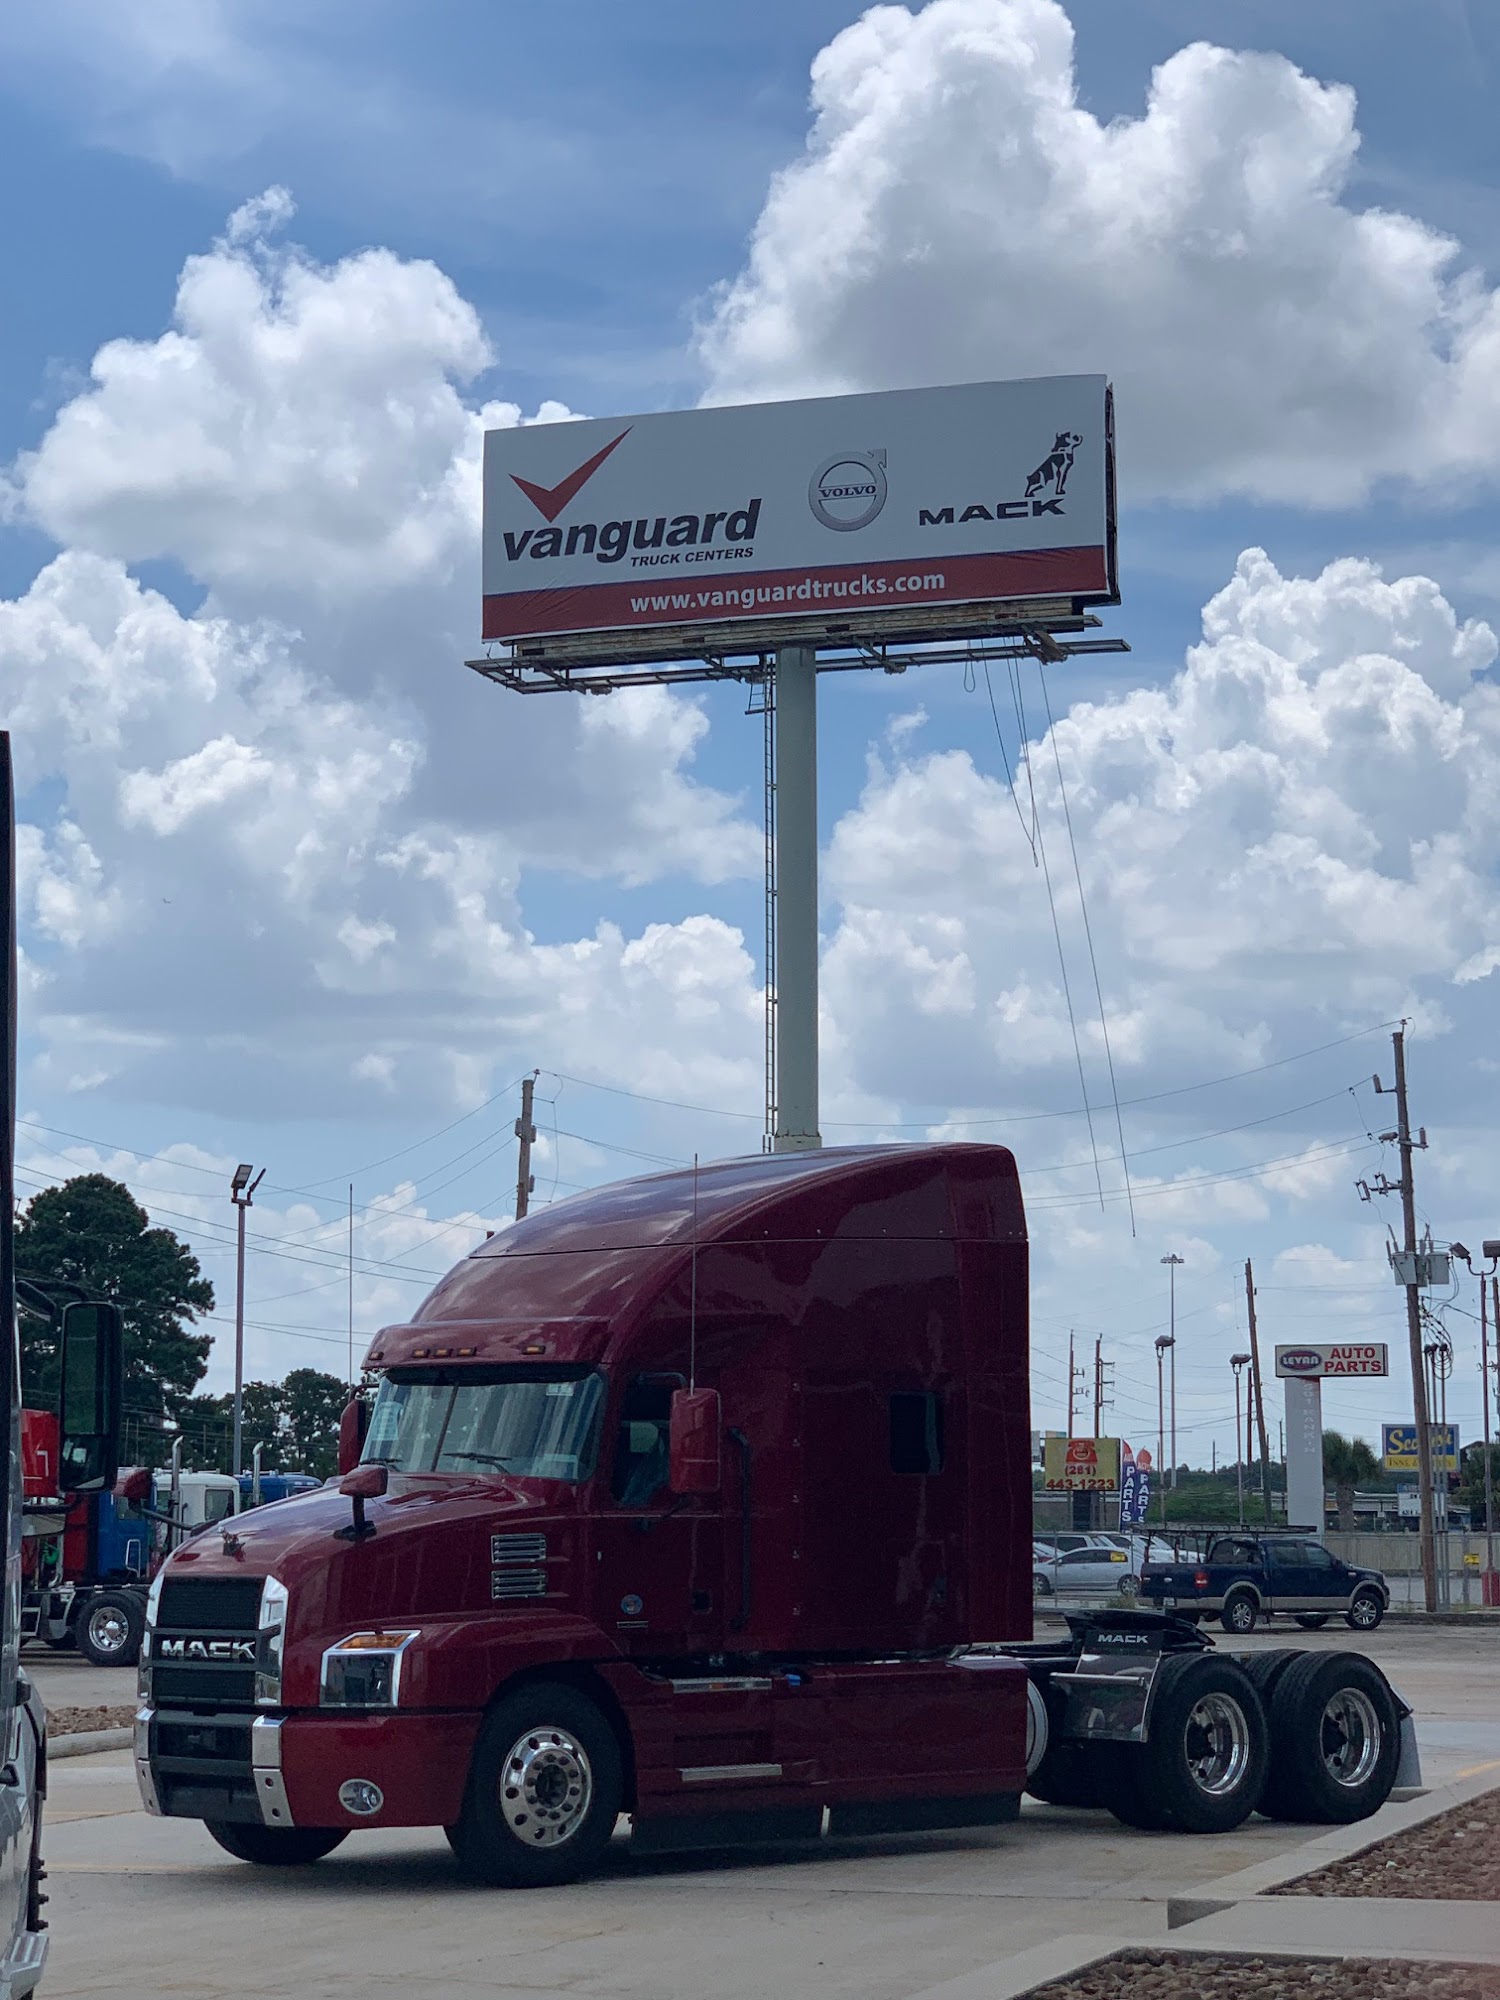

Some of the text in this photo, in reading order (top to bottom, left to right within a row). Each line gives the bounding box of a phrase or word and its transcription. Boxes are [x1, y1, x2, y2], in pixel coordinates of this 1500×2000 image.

[819, 485, 876, 498] VOLVO
[919, 498, 1066, 526] MACK
[503, 498, 762, 564] vanguard
[631, 547, 754, 567] TRUCK CENTERS
[631, 572, 945, 613] www.vanguardtrucks.com
[1330, 1347, 1376, 1359] AUTO
[1324, 1361, 1381, 1373] PARTS
[1065, 1466, 1096, 1476] (281)
[1046, 1479, 1115, 1490] 443-1223
[1122, 1466, 1135, 1522] PARTS
[1138, 1474, 1149, 1523] PARTS
[1098, 1634, 1149, 1644] MACK
[161, 1640, 256, 1660] MACK
